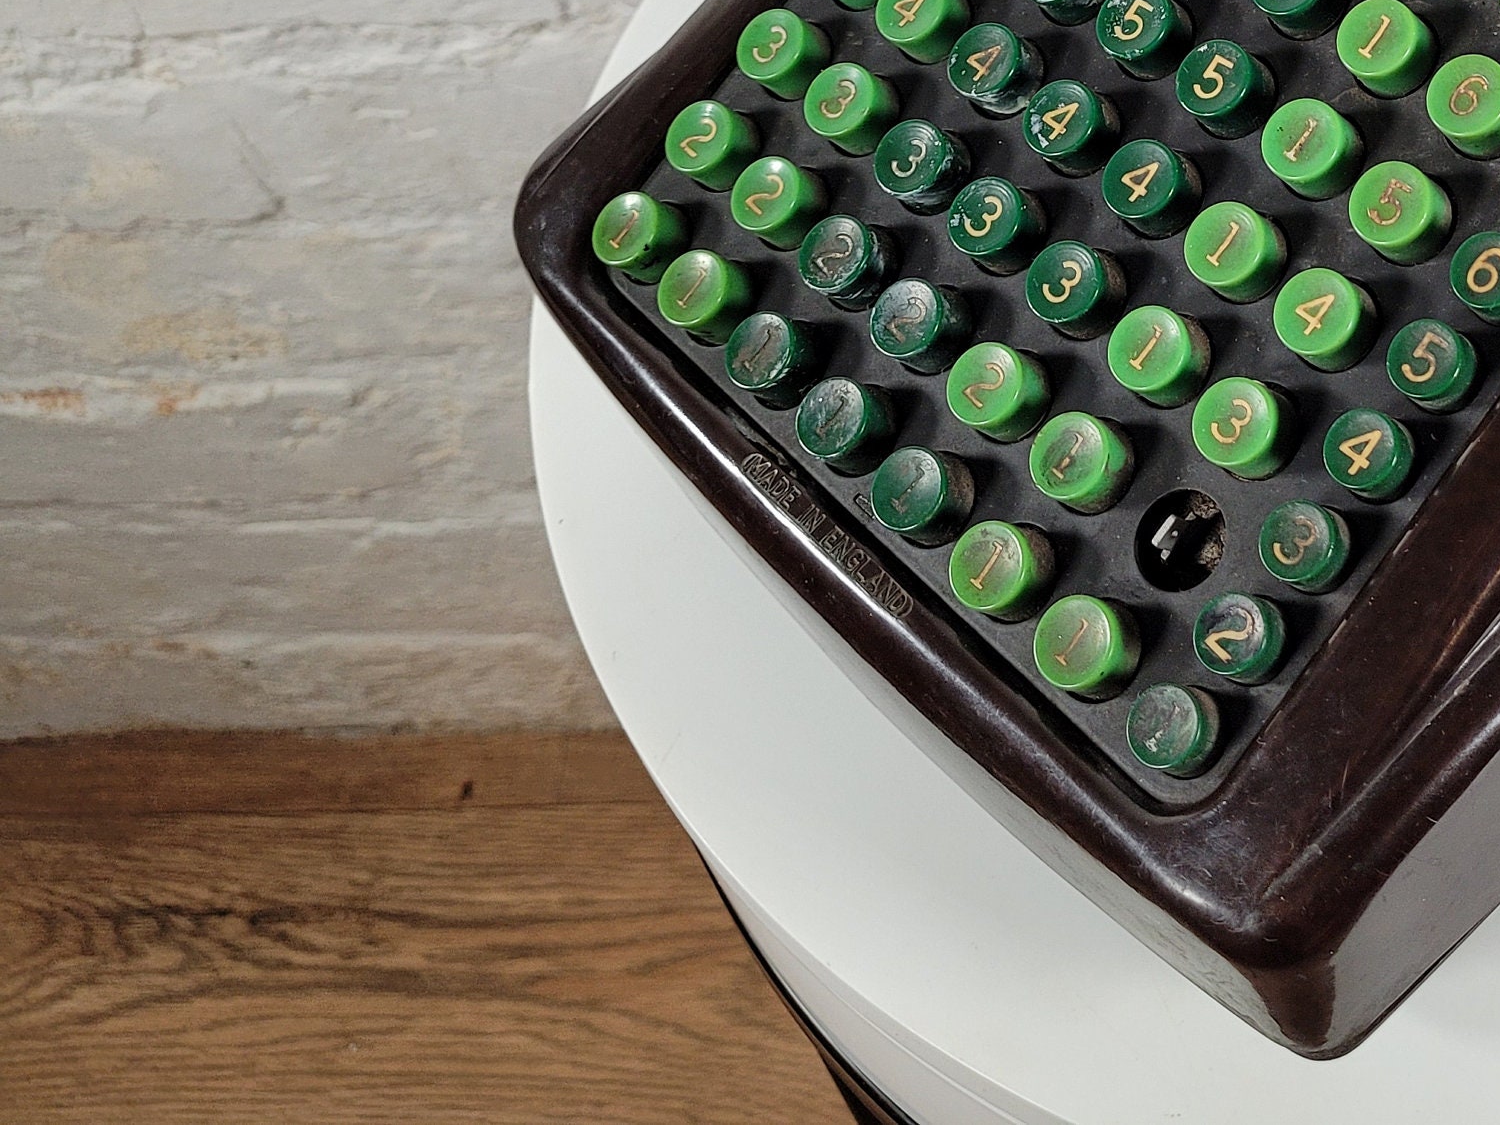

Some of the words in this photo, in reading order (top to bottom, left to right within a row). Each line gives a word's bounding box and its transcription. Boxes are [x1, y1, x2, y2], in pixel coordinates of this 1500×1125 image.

[752, 25, 788, 63] 3
[1358, 14, 1392, 59] 1
[966, 45, 1001, 82] 4
[1192, 53, 1235, 100] 5
[820, 79, 856, 119] 3
[1449, 74, 1489, 115] 6
[680, 117, 718, 159] 2
[1041, 101, 1080, 140] 4
[1283, 118, 1318, 162] 1
[891, 139, 927, 178] 3
[745, 174, 784, 216] 2
[1120, 161, 1160, 203] 4
[1367, 178, 1412, 226] 5
[608, 209, 640, 249] 1
[964, 195, 1003, 238] 3
[812, 233, 854, 278] 2
[1205, 221, 1240, 267] 1
[676, 267, 707, 309] 1
[1042, 260, 1083, 304] 3
[1295, 293, 1336, 335] 4
[1129, 324, 1163, 371] 1
[1401, 331, 1450, 383] 5
[962, 362, 1006, 409] 2
[1210, 398, 1252, 444] 3
[1051, 431, 1084, 480] 1
[1338, 428, 1383, 476] 4
[748, 453, 802, 513] MADE
[798, 503, 827, 536] IN
[819, 524, 911, 618] ENGLAND
[1272, 515, 1318, 566] 3
[968, 540, 1004, 591] 1
[1054, 618, 1090, 666] 1
[1204, 606, 1255, 664] 2
